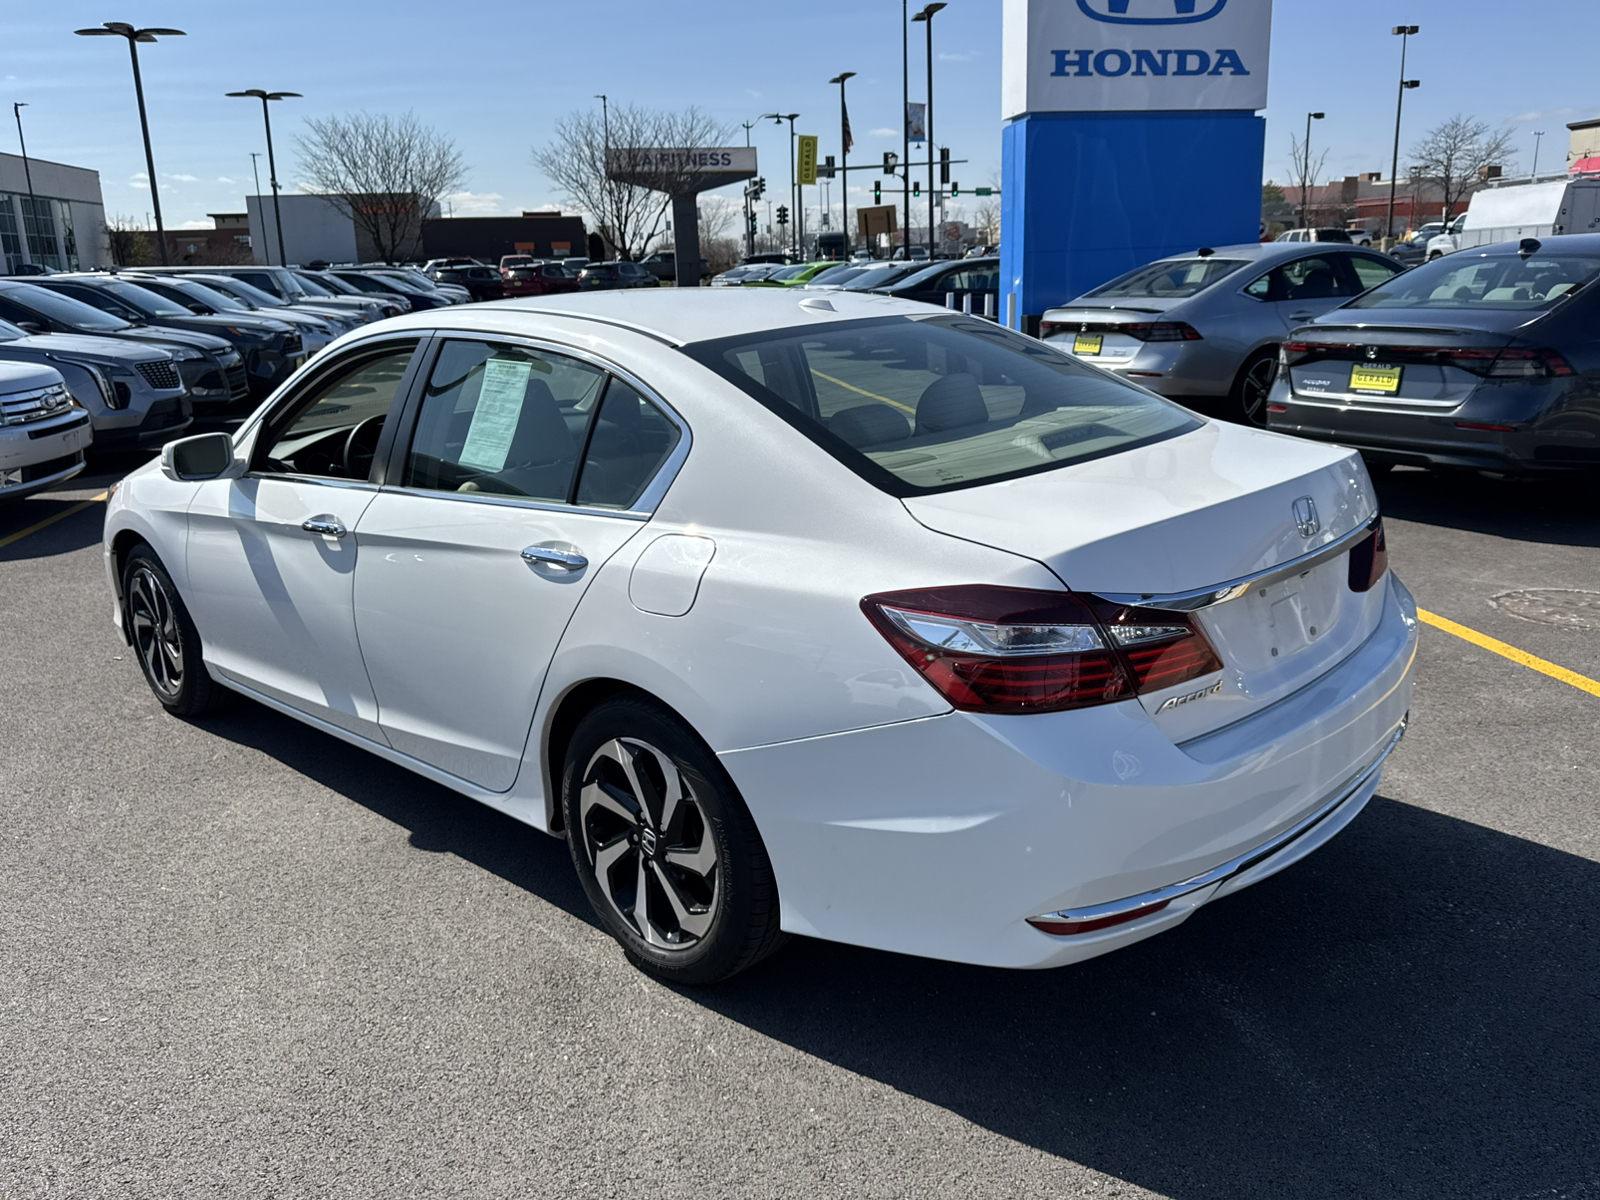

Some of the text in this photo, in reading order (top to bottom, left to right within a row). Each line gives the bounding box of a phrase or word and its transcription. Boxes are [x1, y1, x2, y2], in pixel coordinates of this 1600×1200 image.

[1050, 49, 1250, 77] HONDA
[659, 152, 732, 167] FITNESS
[803, 141, 811, 179] GERALD
[1362, 362, 1392, 370] GERALD
[1357, 374, 1393, 384] GERALD
[1155, 679, 1224, 715] Accord
